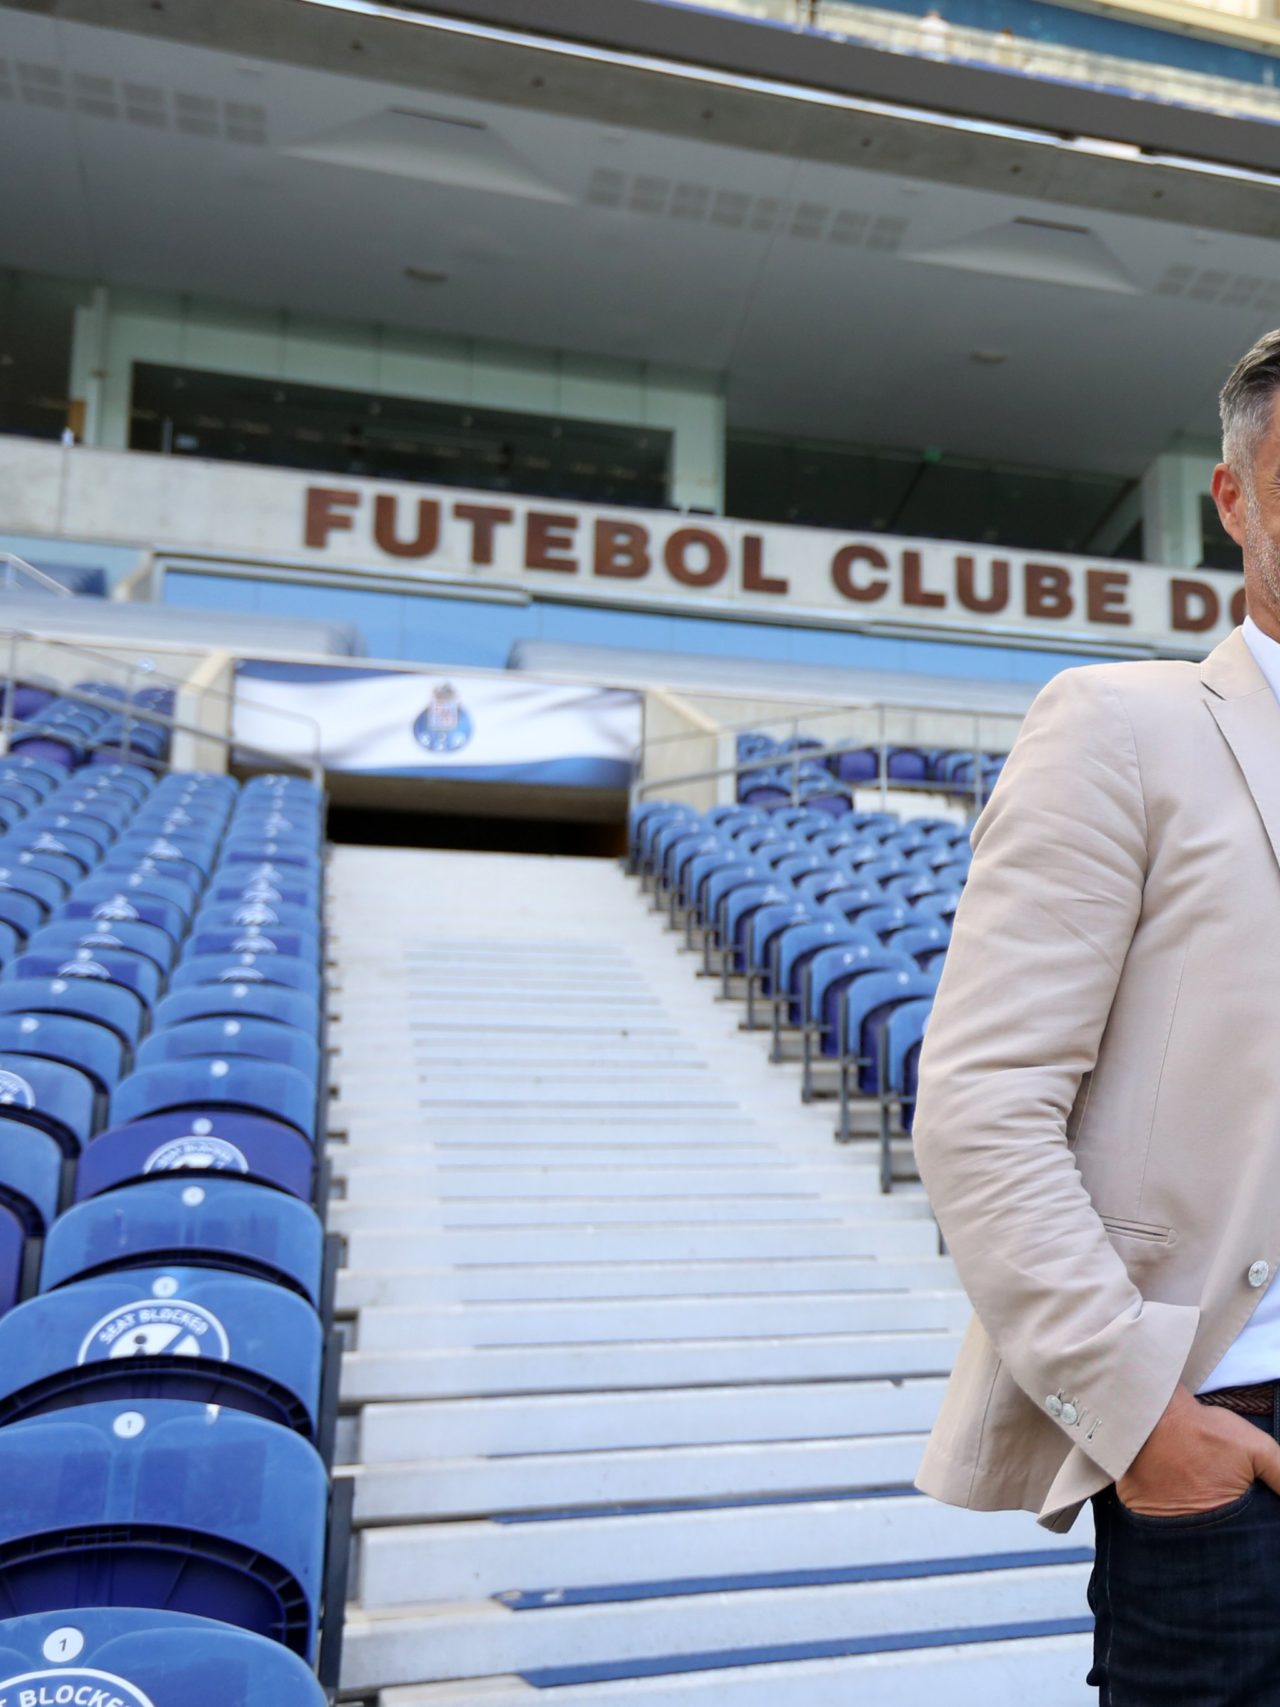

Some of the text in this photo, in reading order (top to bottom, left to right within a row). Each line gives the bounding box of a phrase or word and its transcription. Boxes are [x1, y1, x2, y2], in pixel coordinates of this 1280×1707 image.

[304, 486, 789, 595] FUTEBOL
[832, 544, 1132, 626] CLUBE
[98, 1307, 209, 1345] SEAT BLOCKED
[59, 1638, 68, 1652] 1
[19, 1684, 133, 1707] BLOCKE
